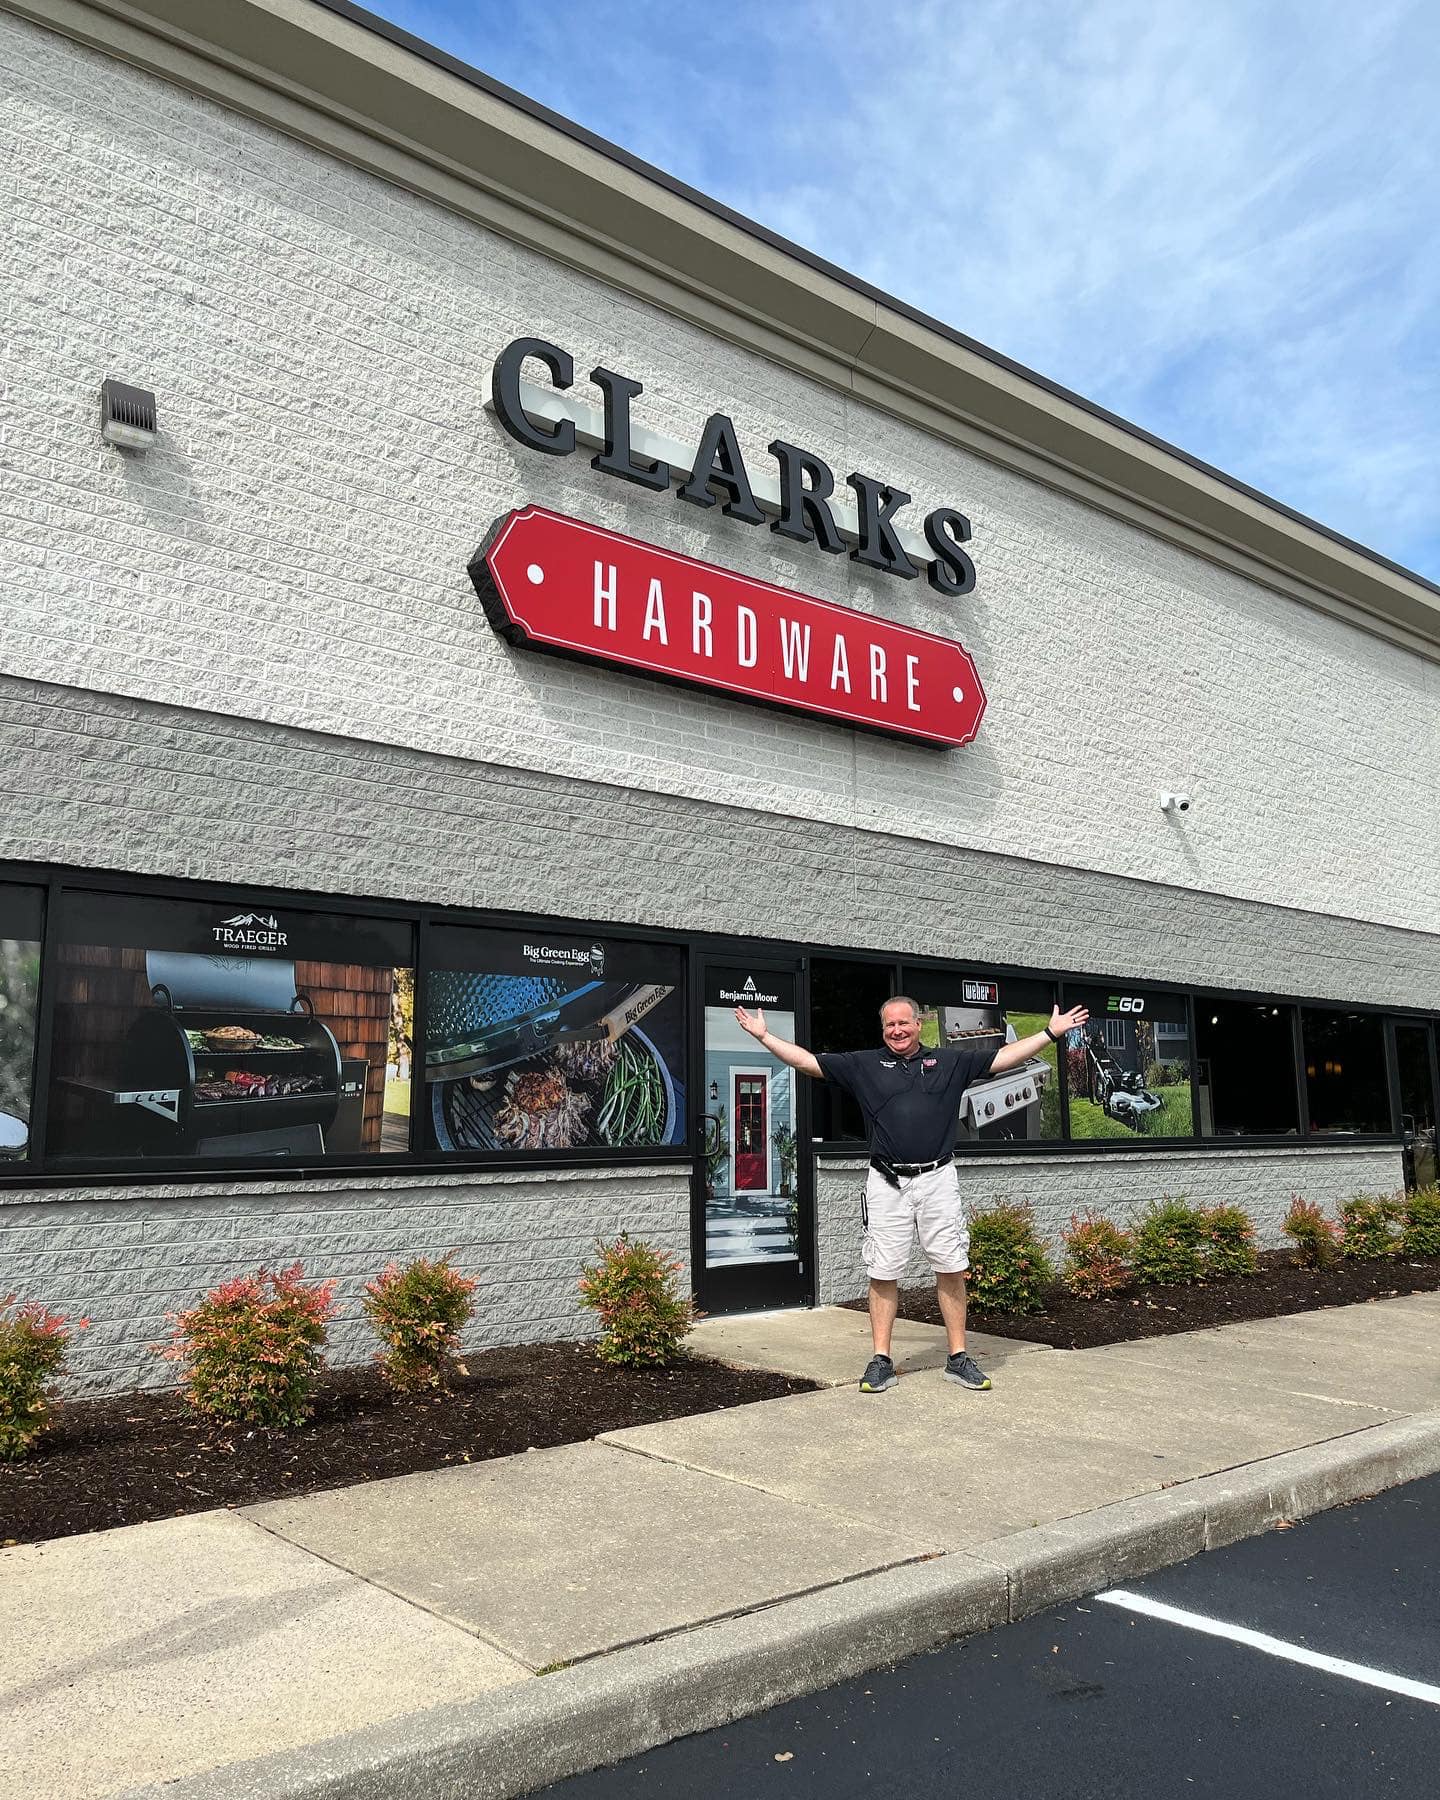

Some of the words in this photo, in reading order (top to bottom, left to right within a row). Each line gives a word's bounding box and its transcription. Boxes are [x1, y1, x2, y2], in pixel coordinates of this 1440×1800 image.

[492, 337, 976, 596] CLARKS
[592, 560, 922, 711] HARDWARE
[212, 927, 288, 946] TRAEGER
[523, 944, 540, 959] Big
[540, 946, 571, 959] Green
[571, 948, 590, 963] Egg
[719, 989, 754, 1002] Benjamin
[754, 992, 778, 1003] Moore
[965, 981, 990, 1001] weber
[1106, 995, 1145, 1013] EGO
[624, 1007, 638, 1024] Big
